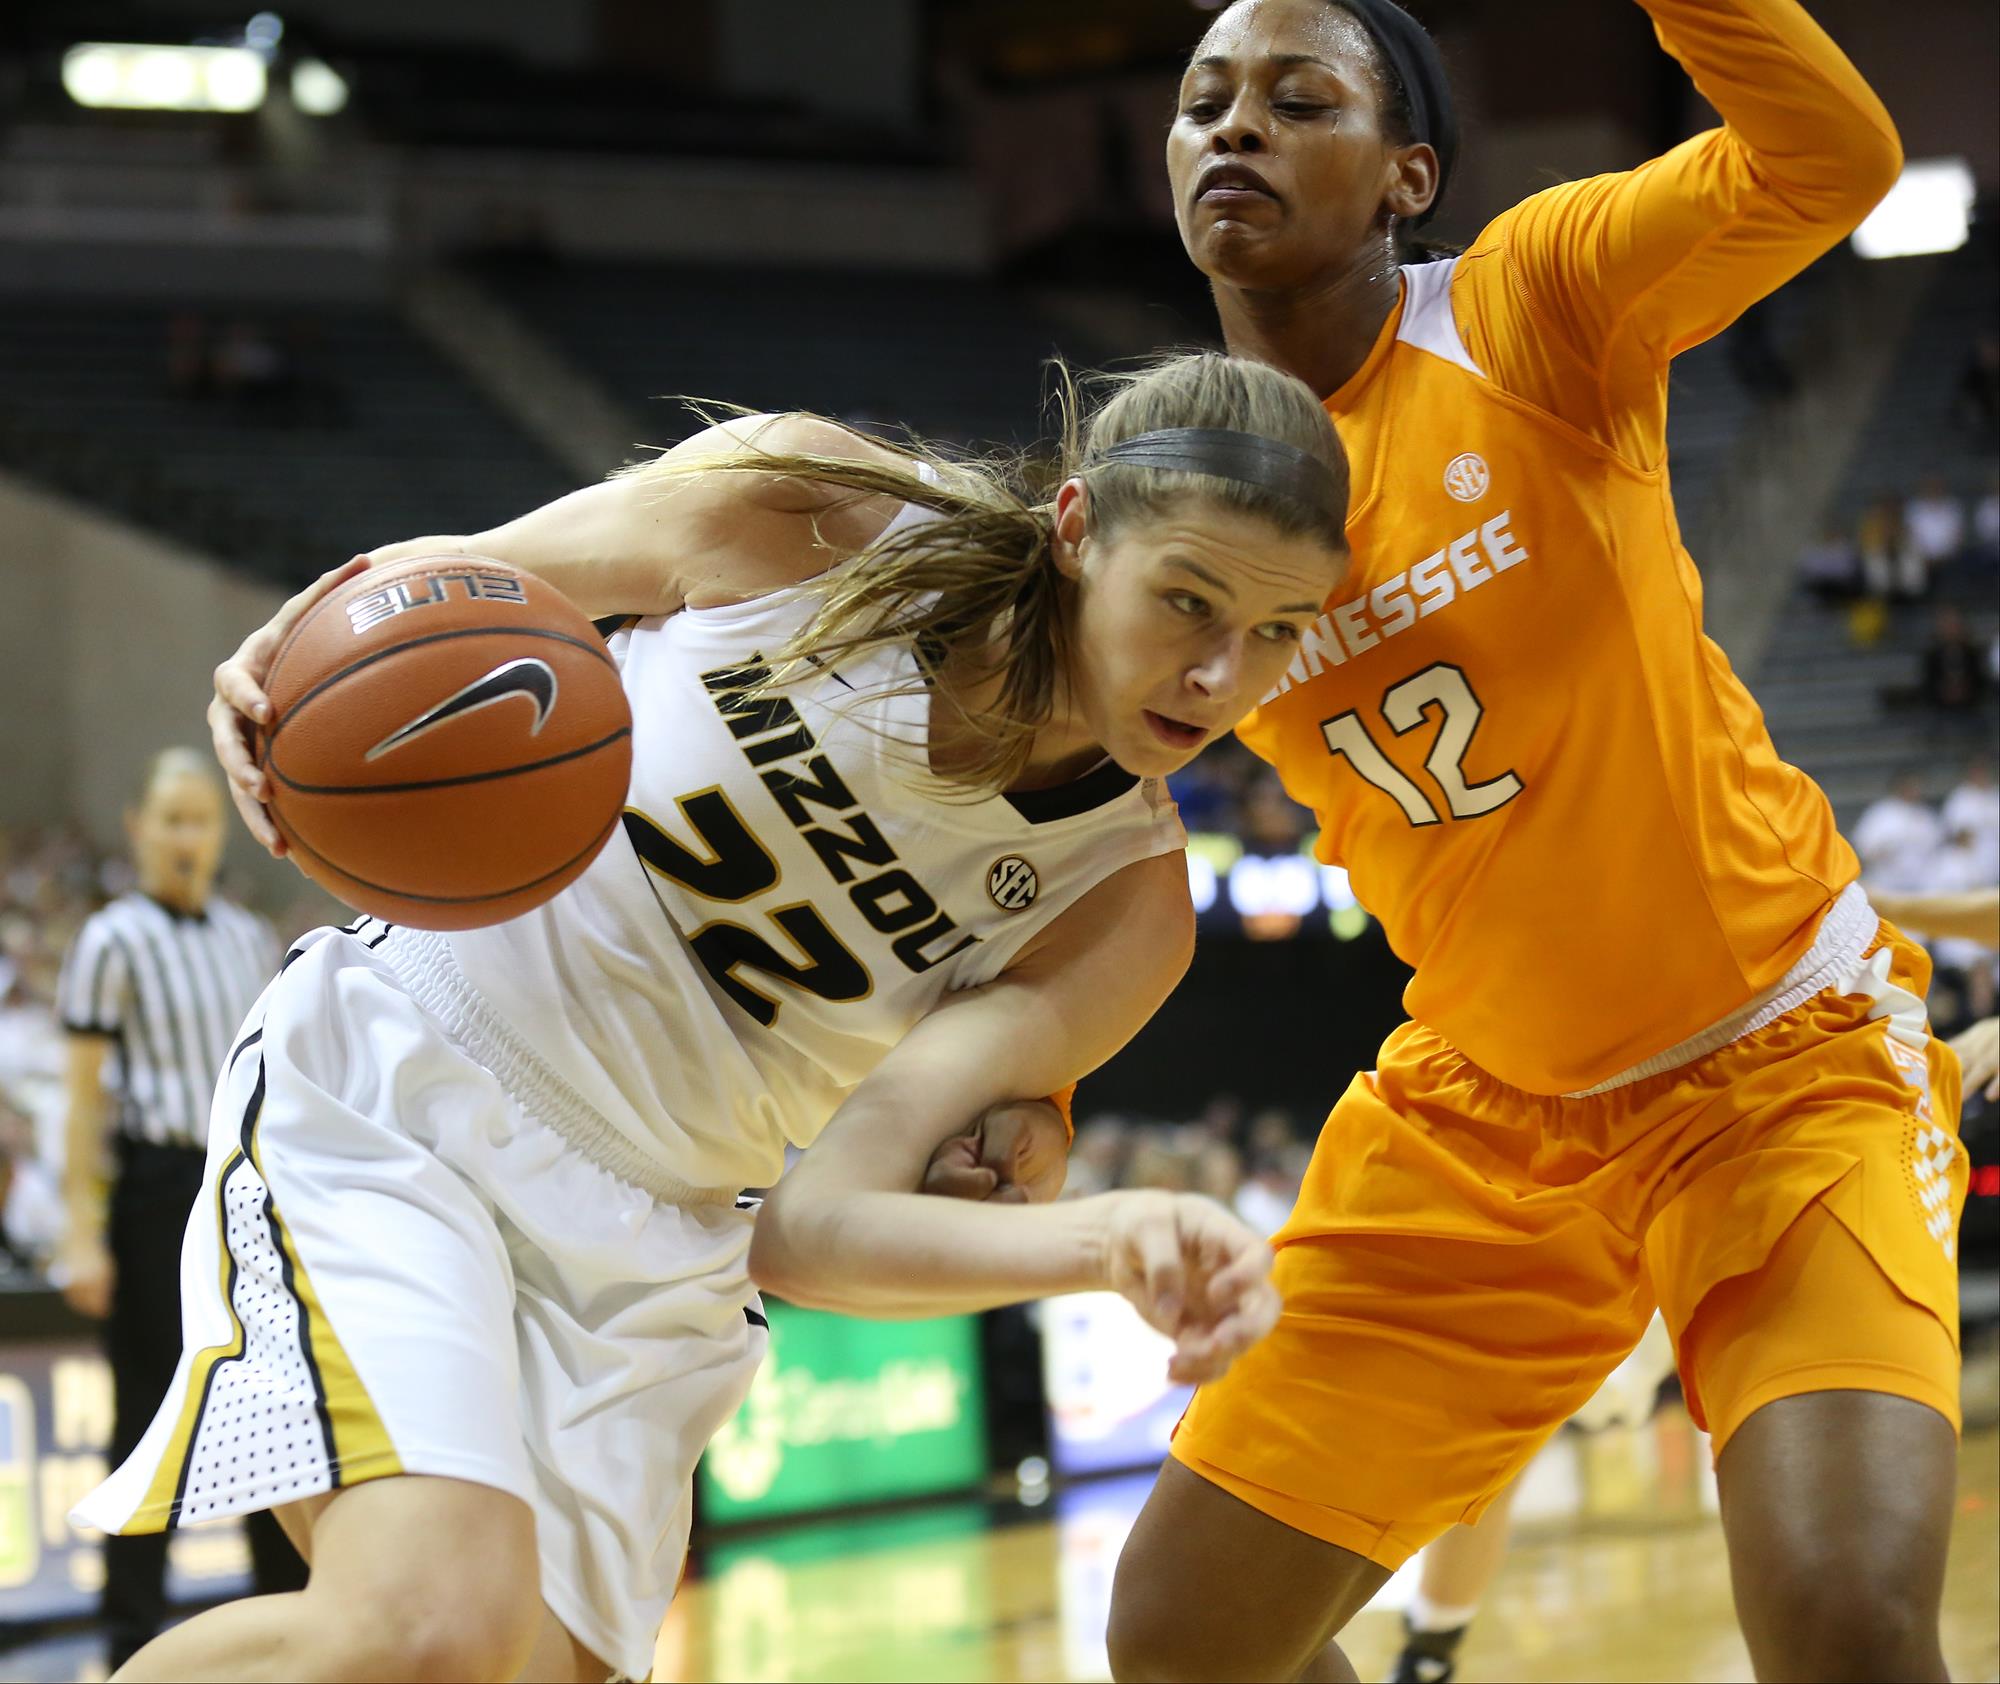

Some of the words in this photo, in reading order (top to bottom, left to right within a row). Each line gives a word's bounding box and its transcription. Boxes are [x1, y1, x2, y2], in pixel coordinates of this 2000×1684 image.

[1448, 458, 1487, 498] SEC
[345, 574, 528, 635] ELITE
[1260, 510, 1529, 706] NESSEE
[698, 650, 984, 974] MIZZOU
[1319, 661, 1526, 828] 12
[621, 784, 874, 1028] 22
[989, 857, 1038, 910] SEC
